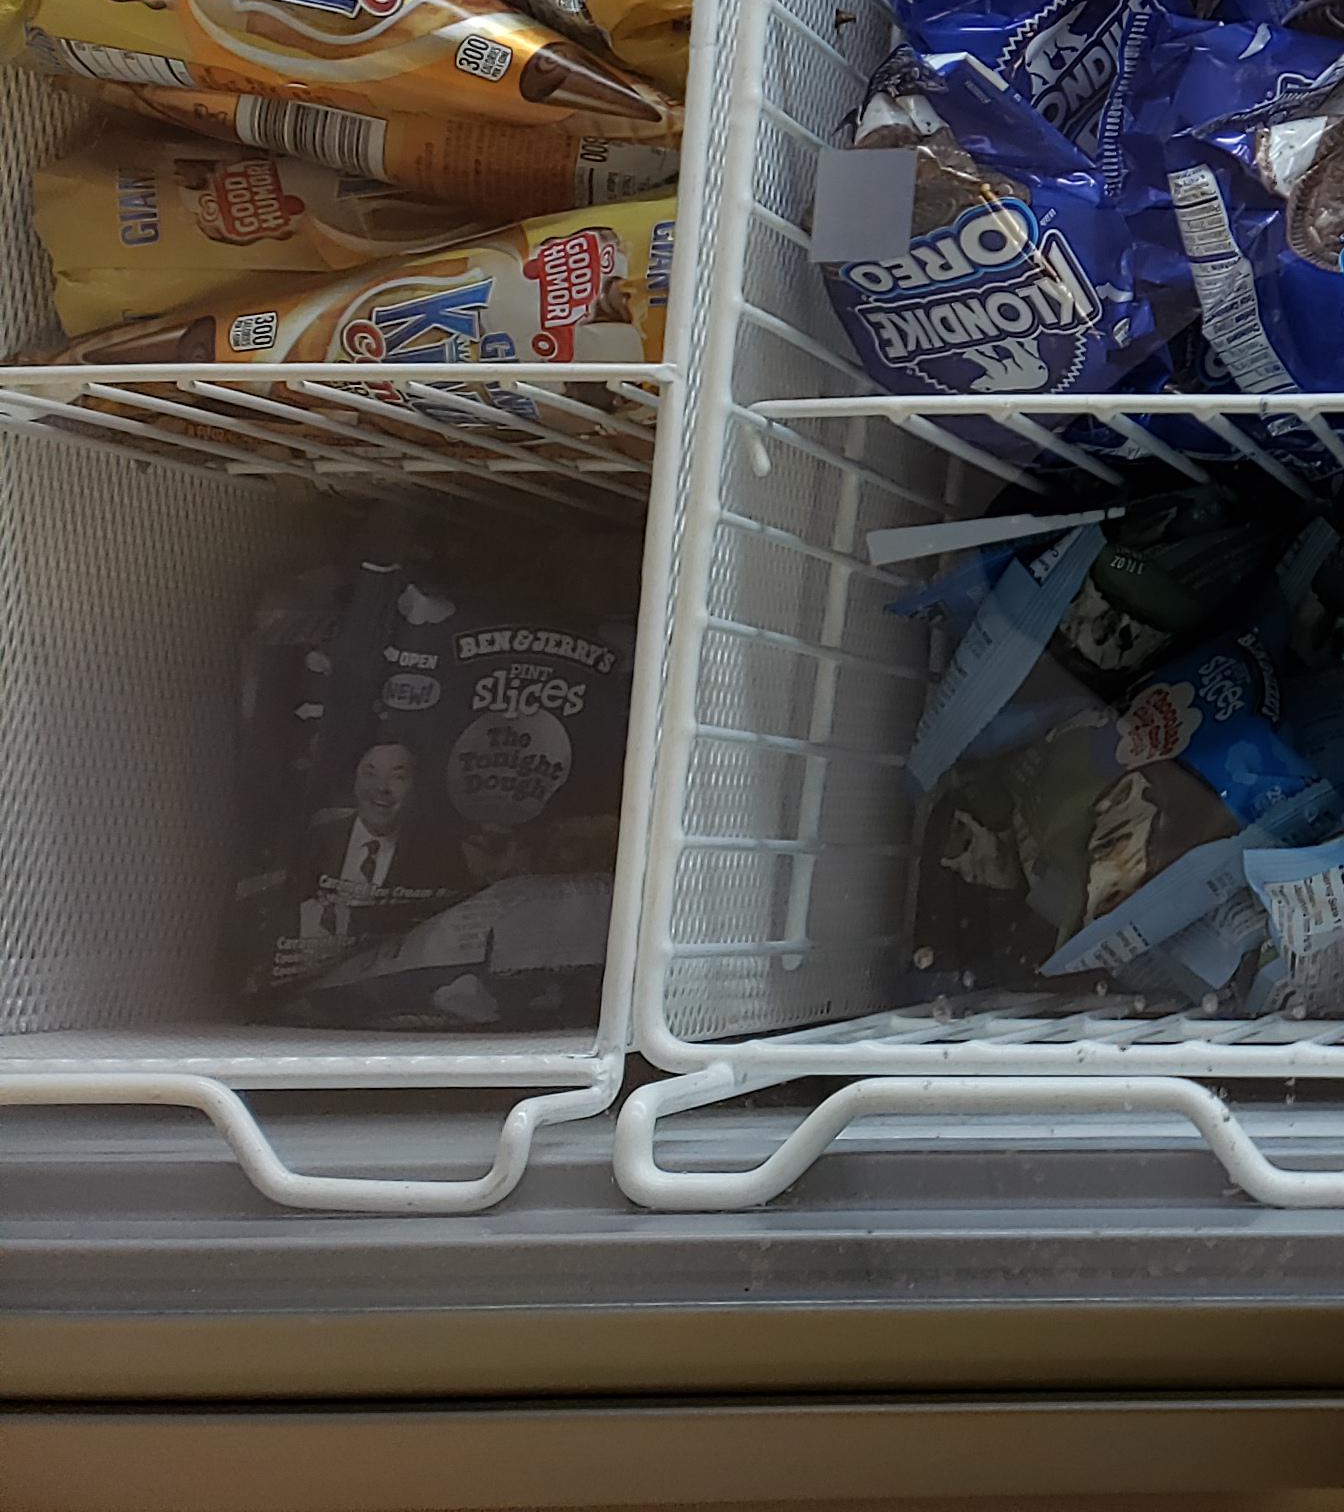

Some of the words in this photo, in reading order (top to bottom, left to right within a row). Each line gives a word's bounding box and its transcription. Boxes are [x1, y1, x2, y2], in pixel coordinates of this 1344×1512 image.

[459, 35, 488, 73] 300
[849, 208, 1030, 292] OREO
[541, 244, 567, 325] HUMOR
[567, 238, 593, 307] GOOD
[867, 241, 1094, 358] KLONDIKE
[252, 311, 277, 351] 300
[399, 653, 438, 670] OPEN
[509, 663, 554, 683] PINT
[471, 670, 587, 718] slices
[487, 728, 532, 751] The
[458, 751, 563, 786] Tonight
